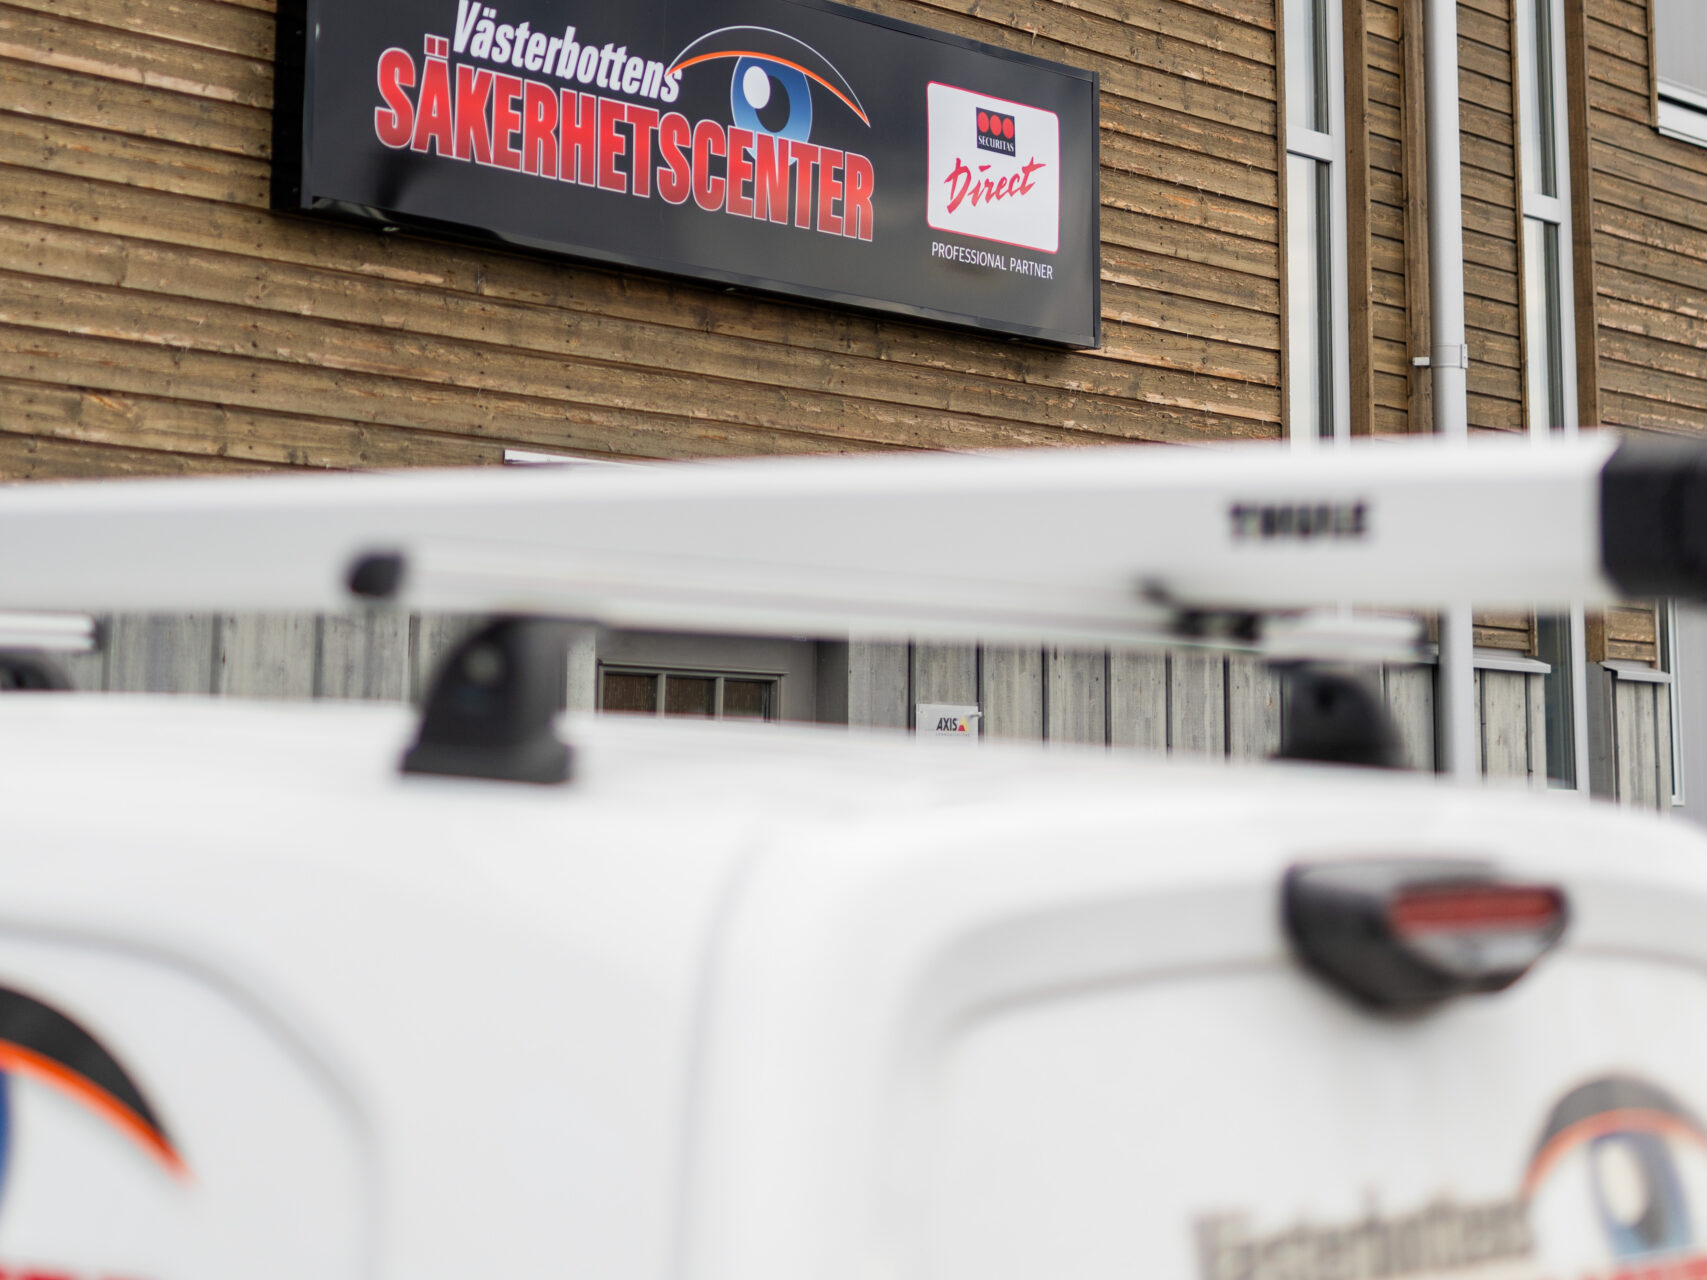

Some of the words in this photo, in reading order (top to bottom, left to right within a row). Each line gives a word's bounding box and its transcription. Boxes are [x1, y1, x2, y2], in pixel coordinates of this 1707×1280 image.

[374, 33, 875, 242] SÄKERHETSCENTER
[977, 134, 1015, 153] SECURITAS
[943, 155, 1047, 214] Direct
[931, 241, 1007, 271] PROFESSIONAL
[1009, 257, 1053, 280] PARTNER
[936, 717, 958, 732] AXIS
